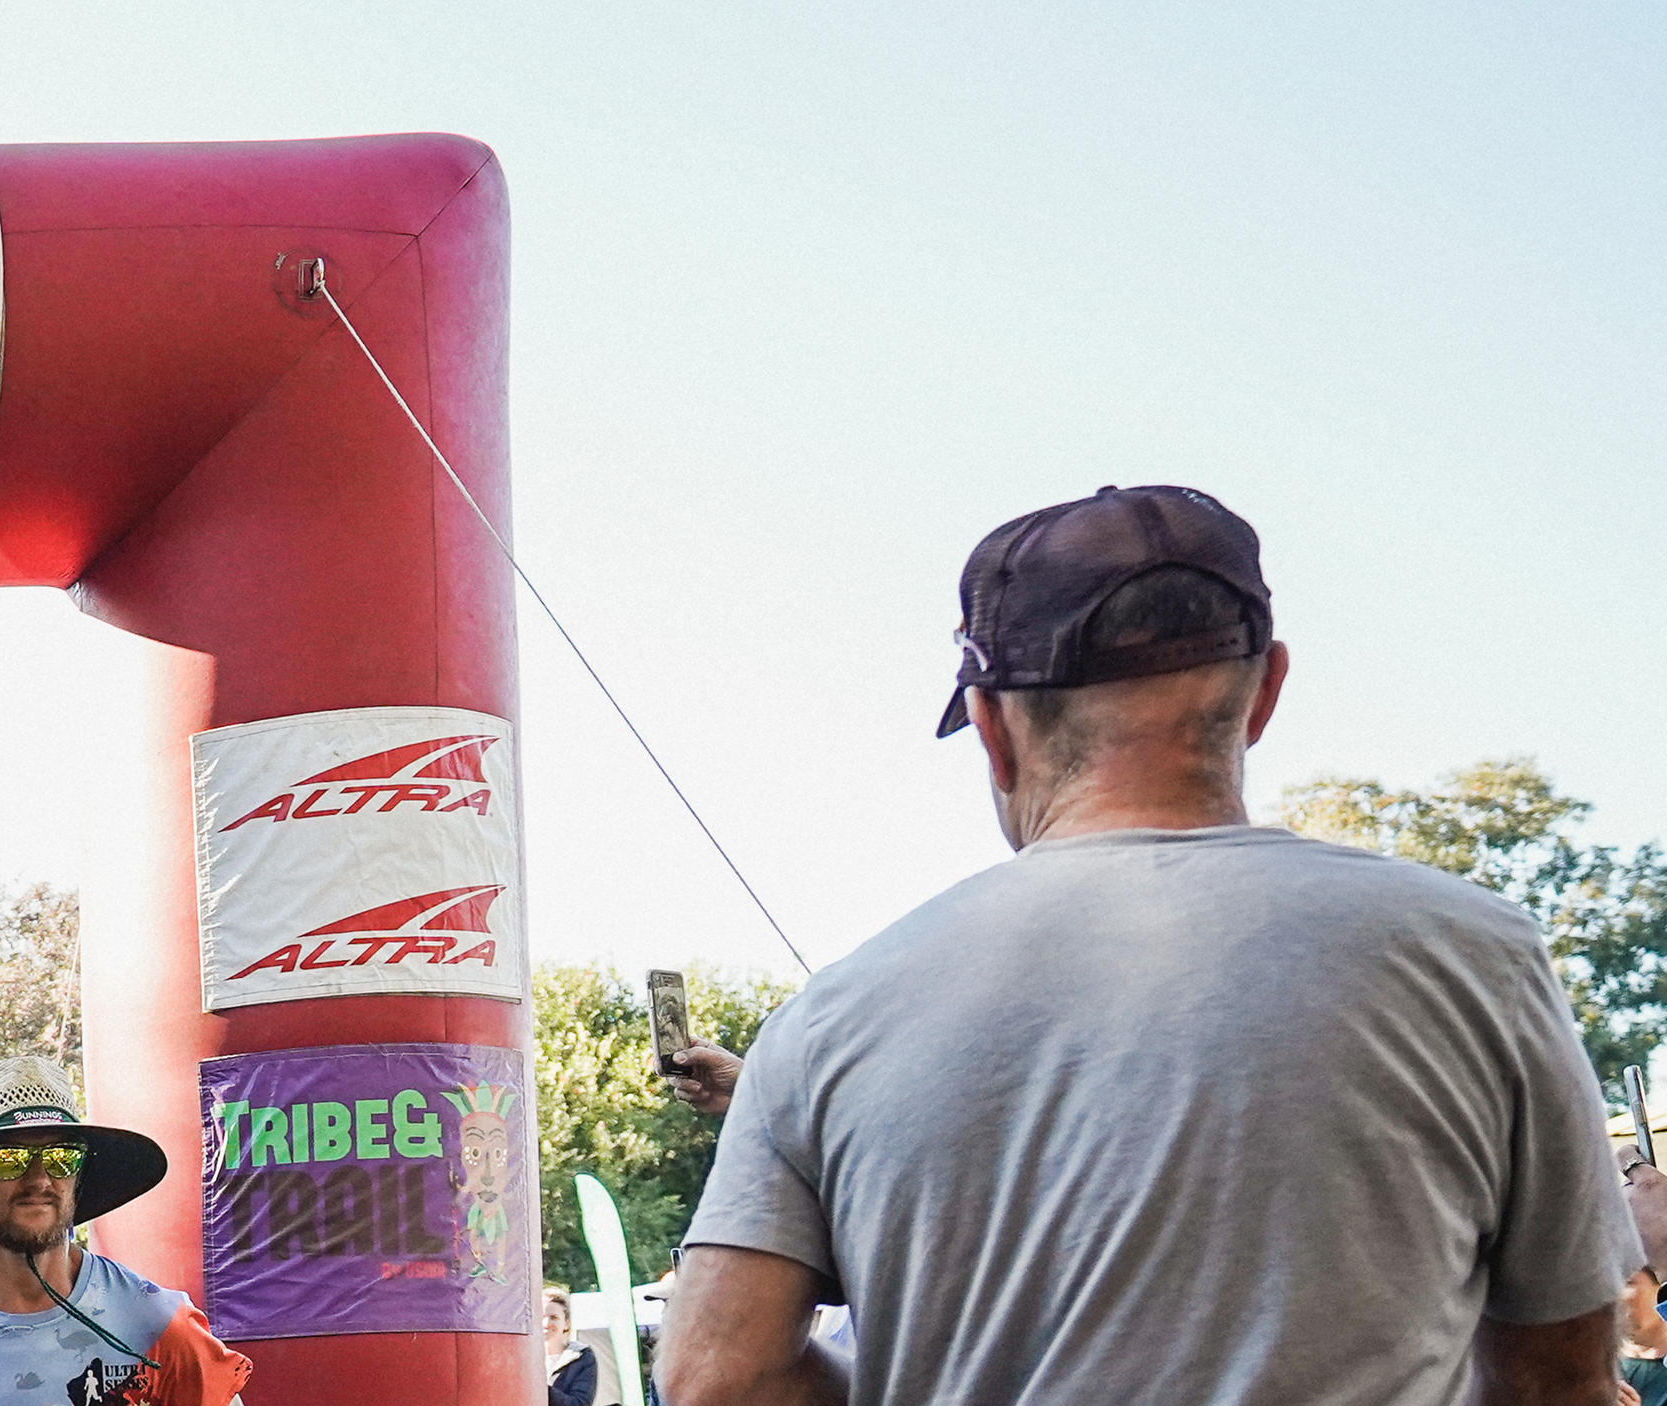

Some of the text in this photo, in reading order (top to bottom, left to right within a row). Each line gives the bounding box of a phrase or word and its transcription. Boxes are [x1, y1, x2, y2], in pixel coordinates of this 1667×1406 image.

[217, 784, 491, 833] ALTRA
[225, 936, 497, 981] ALTRA
[219, 1164, 447, 1262] TRAIL
